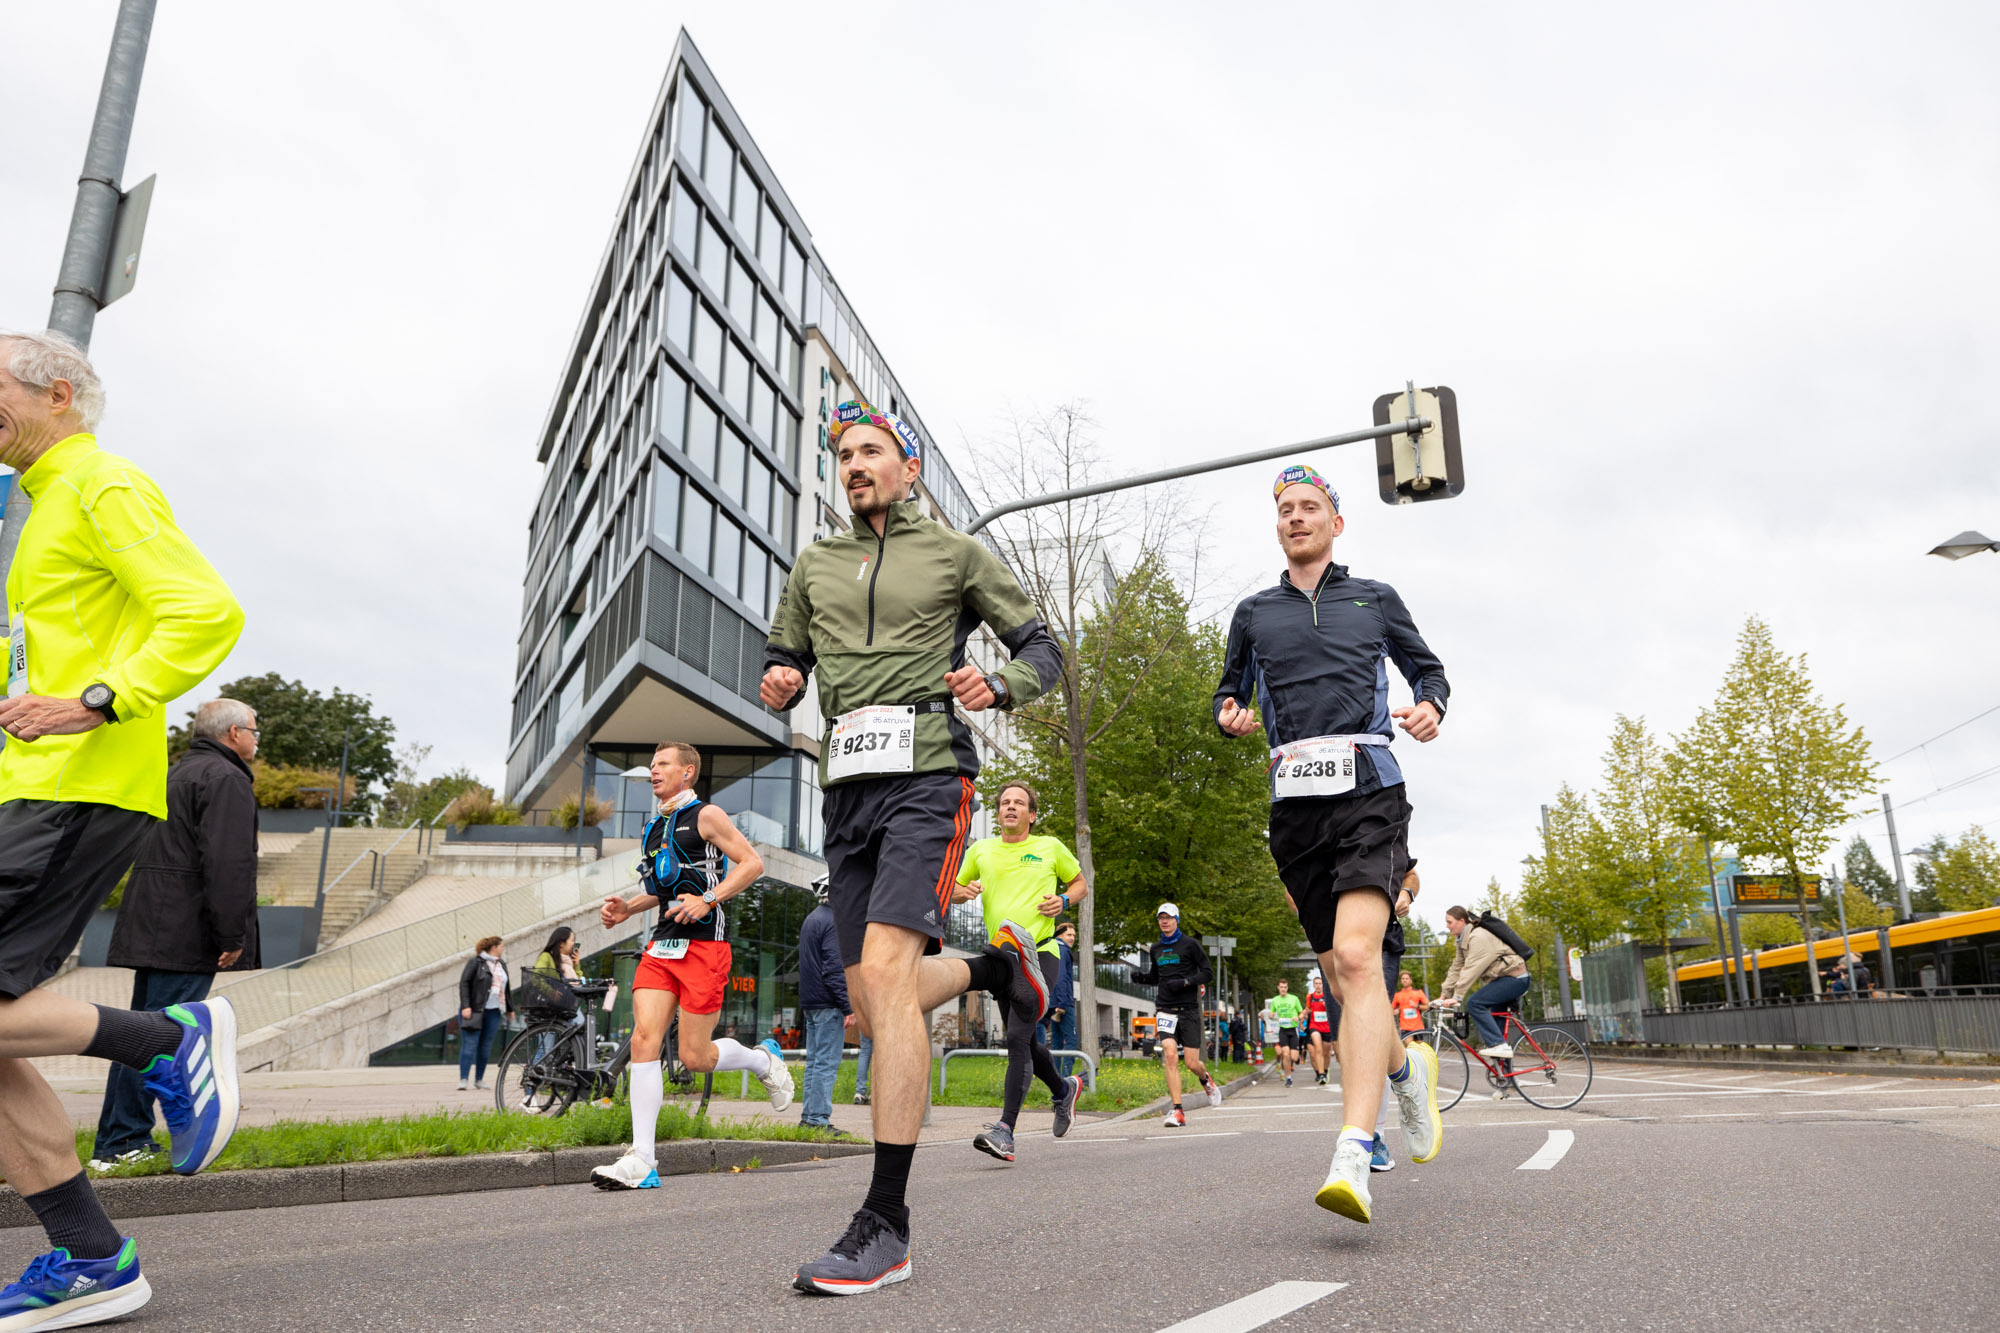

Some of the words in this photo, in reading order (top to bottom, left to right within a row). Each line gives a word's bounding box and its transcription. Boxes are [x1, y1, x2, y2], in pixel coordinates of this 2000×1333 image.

[841, 407, 861, 420] MAPEI
[817, 365, 829, 481] PARK
[898, 423, 921, 459] MAPE
[1286, 470, 1304, 481] MAPEI
[854, 707, 879, 718] September
[843, 732, 892, 756] 9237
[1291, 760, 1337, 778] 9238
[731, 975, 755, 993] VIER
[66, 1278, 98, 1299] adidas
